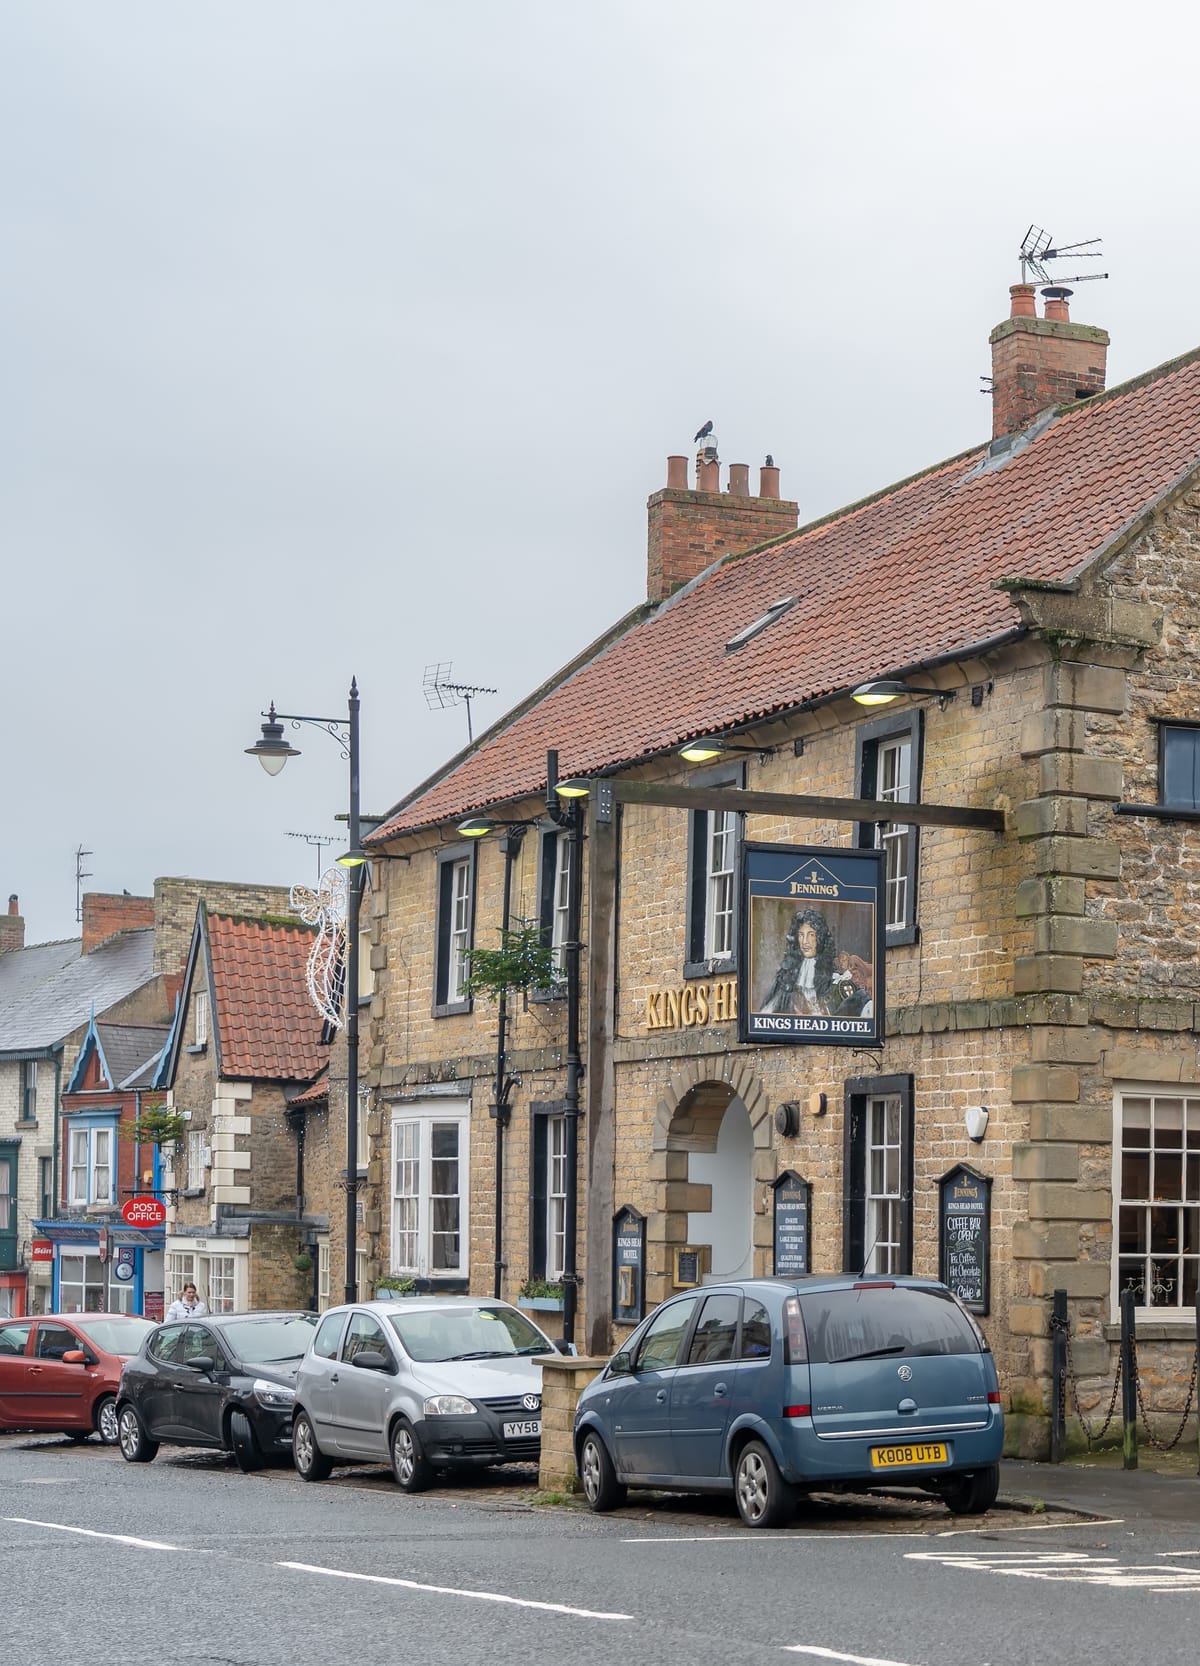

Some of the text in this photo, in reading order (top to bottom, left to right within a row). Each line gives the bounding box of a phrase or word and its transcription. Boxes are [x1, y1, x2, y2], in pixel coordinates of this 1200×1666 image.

[790, 881, 839, 897] JENNINGS
[646, 985, 709, 1029] KINGS
[753, 1017, 871, 1033] KINGS HEAD HOTEL
[133, 1203, 158, 1212] POST
[127, 1212, 162, 1221] OFFICE
[947, 1216, 981, 1231] COFFEE BAR
[957, 1229, 974, 1241] OPEN
[631, 1237, 642, 1247] HEA
[508, 1422, 539, 1435] YY58
[916, 1446, 941, 1460] UTB
